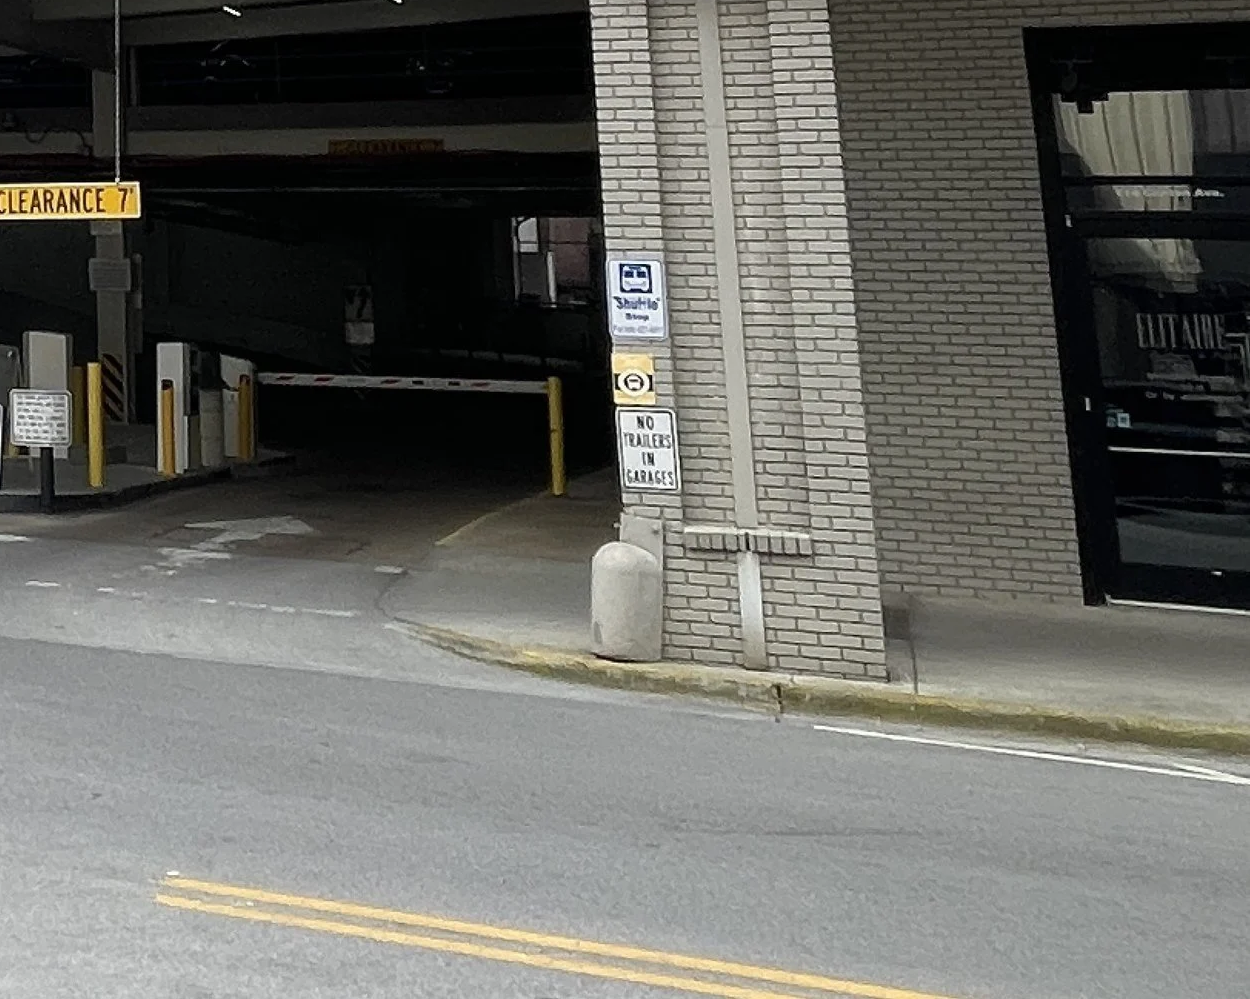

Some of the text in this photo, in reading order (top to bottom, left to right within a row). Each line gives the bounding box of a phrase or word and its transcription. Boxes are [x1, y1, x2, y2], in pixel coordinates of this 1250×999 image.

[636, 415, 654, 431] NO
[623, 433, 671, 449] TRAILERS
[642, 451, 655, 466] IN
[626, 468, 674, 486] GARAGES
